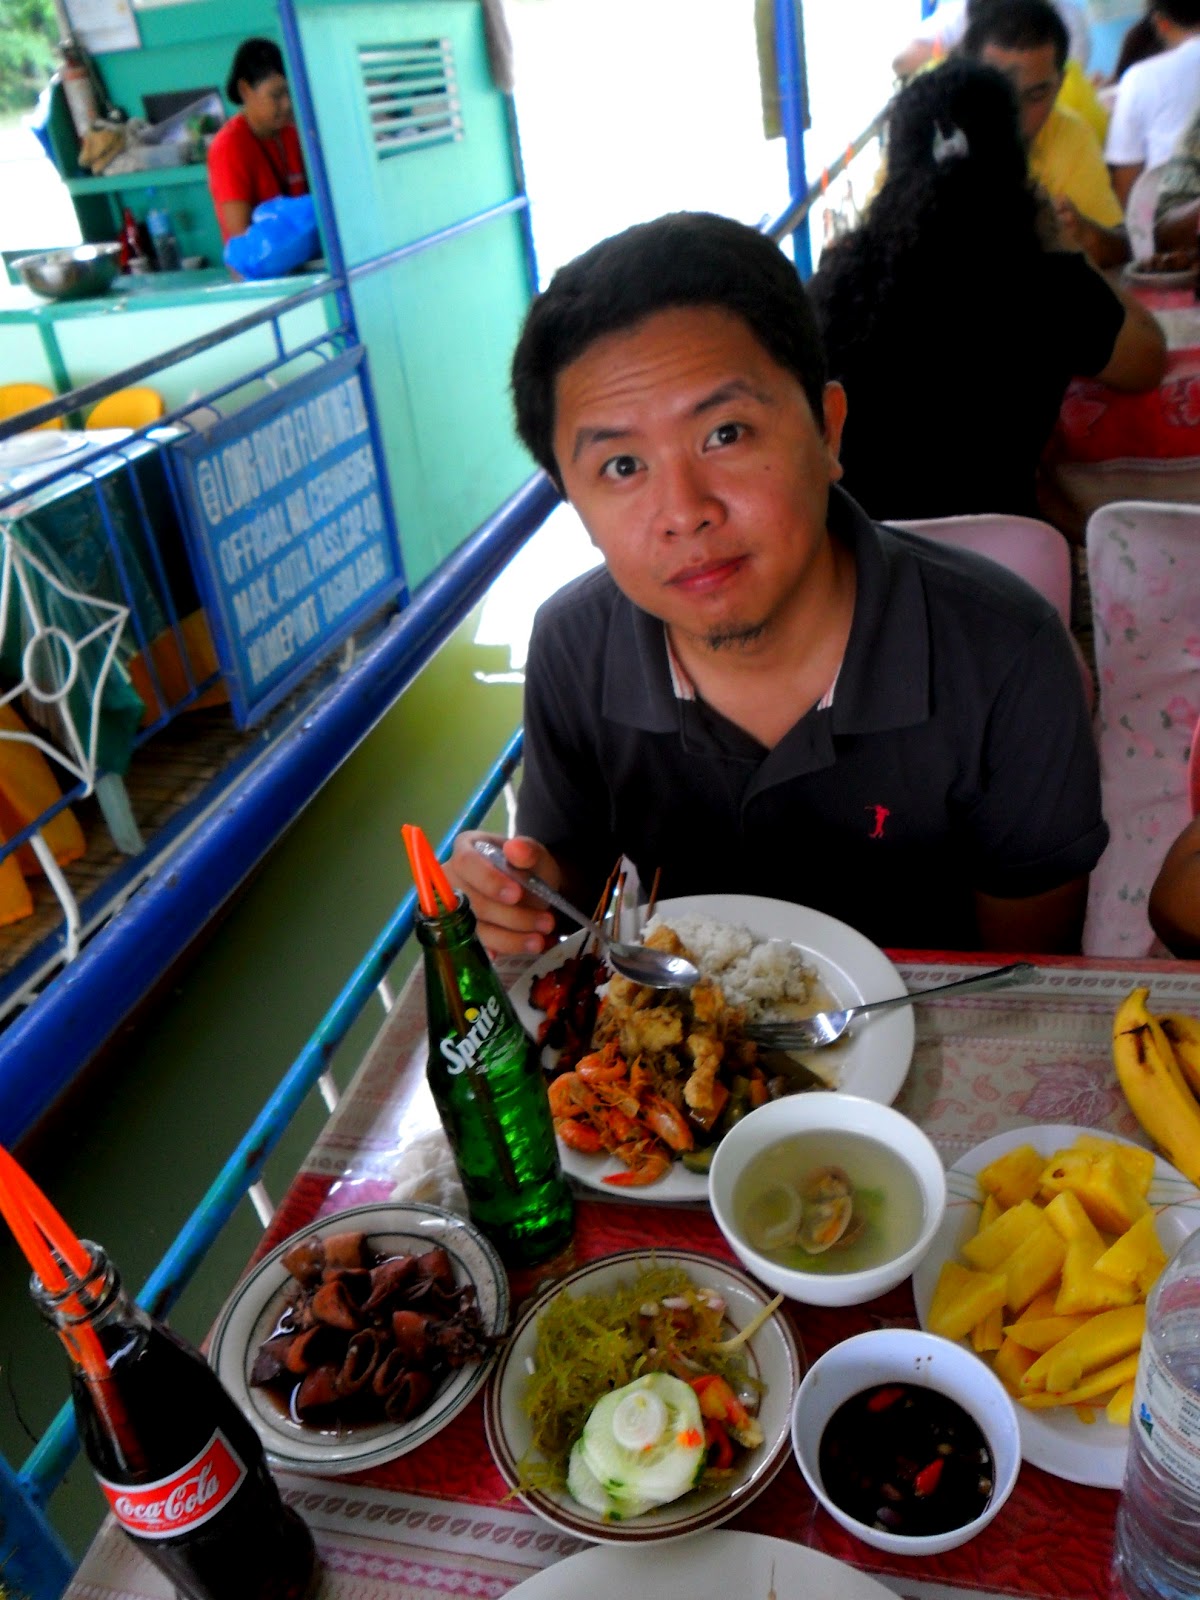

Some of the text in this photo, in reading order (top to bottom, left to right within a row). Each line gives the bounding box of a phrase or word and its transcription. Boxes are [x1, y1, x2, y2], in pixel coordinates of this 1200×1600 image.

[219, 503, 292, 585] OFFICIAL
[247, 595, 319, 685] HOMEPORT
[440, 995, 500, 1075] Sprite
[115, 1460, 219, 1524] Coca-Cola
